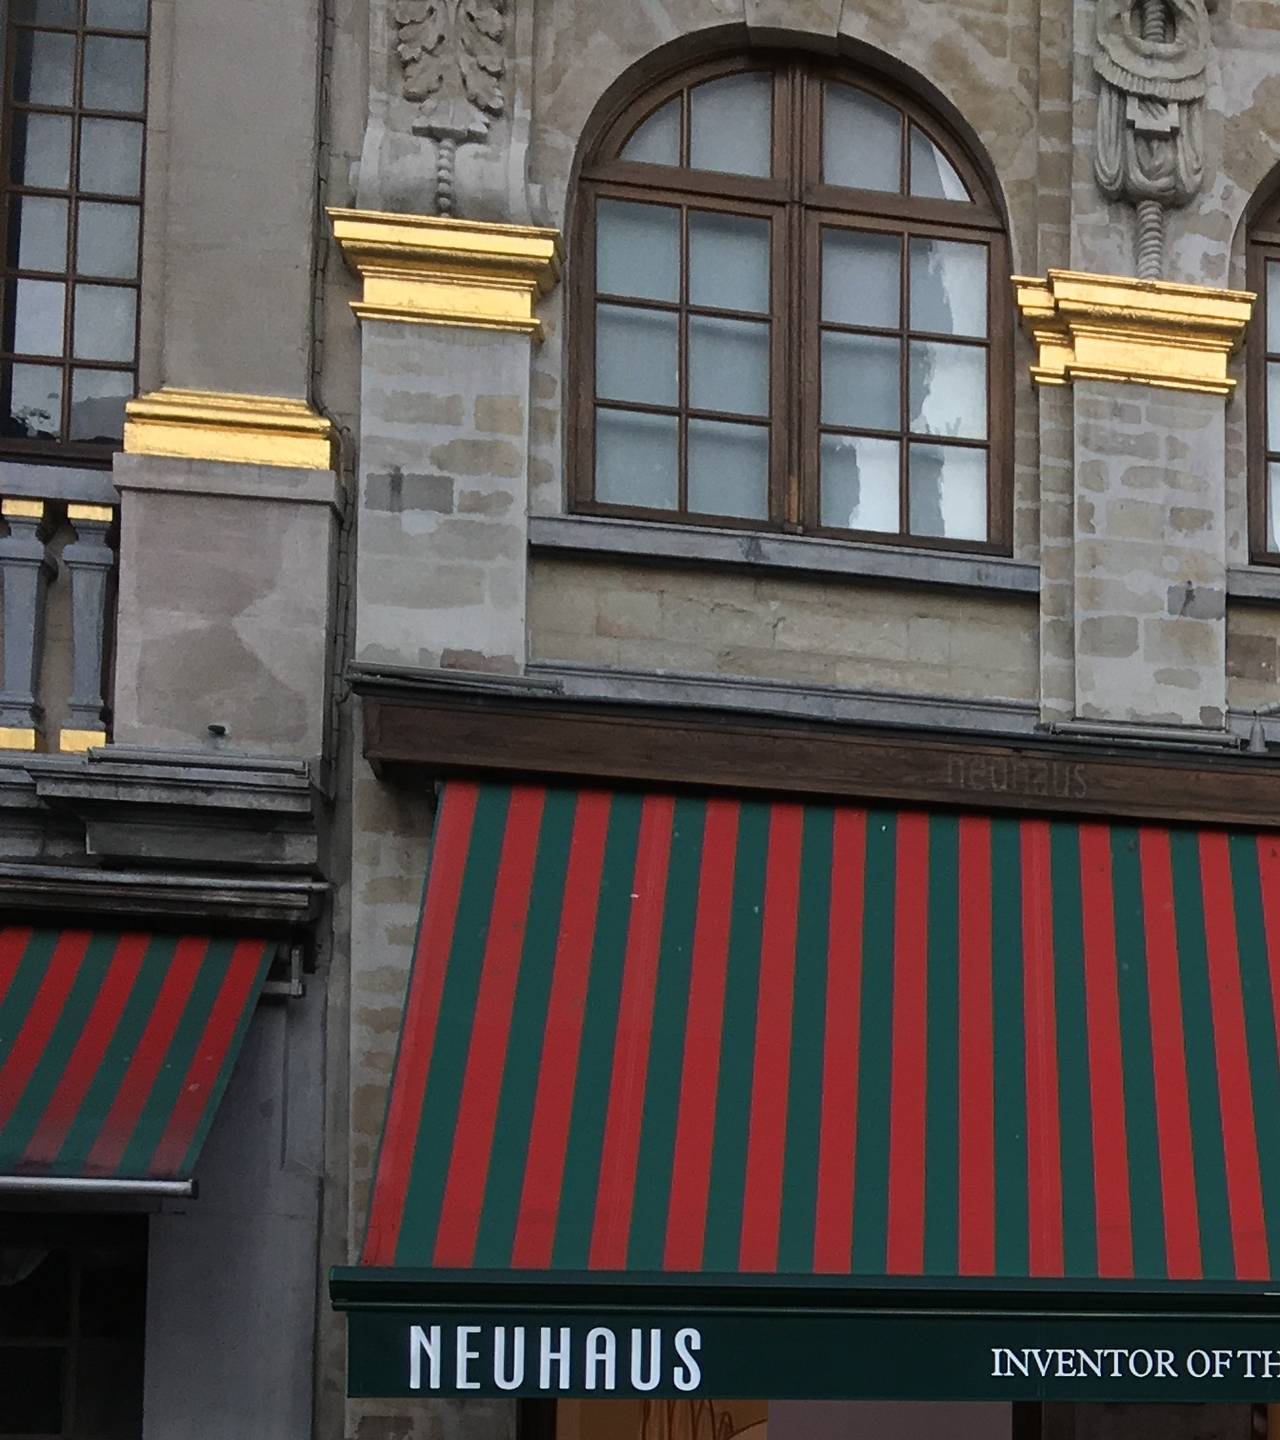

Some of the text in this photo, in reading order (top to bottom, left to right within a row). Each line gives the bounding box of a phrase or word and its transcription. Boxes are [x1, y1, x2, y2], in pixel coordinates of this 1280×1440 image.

[409, 1325, 701, 1392] NEUHAUS
[991, 1348, 1179, 1378] INVENTOR
[1186, 1349, 1233, 1378] OF
